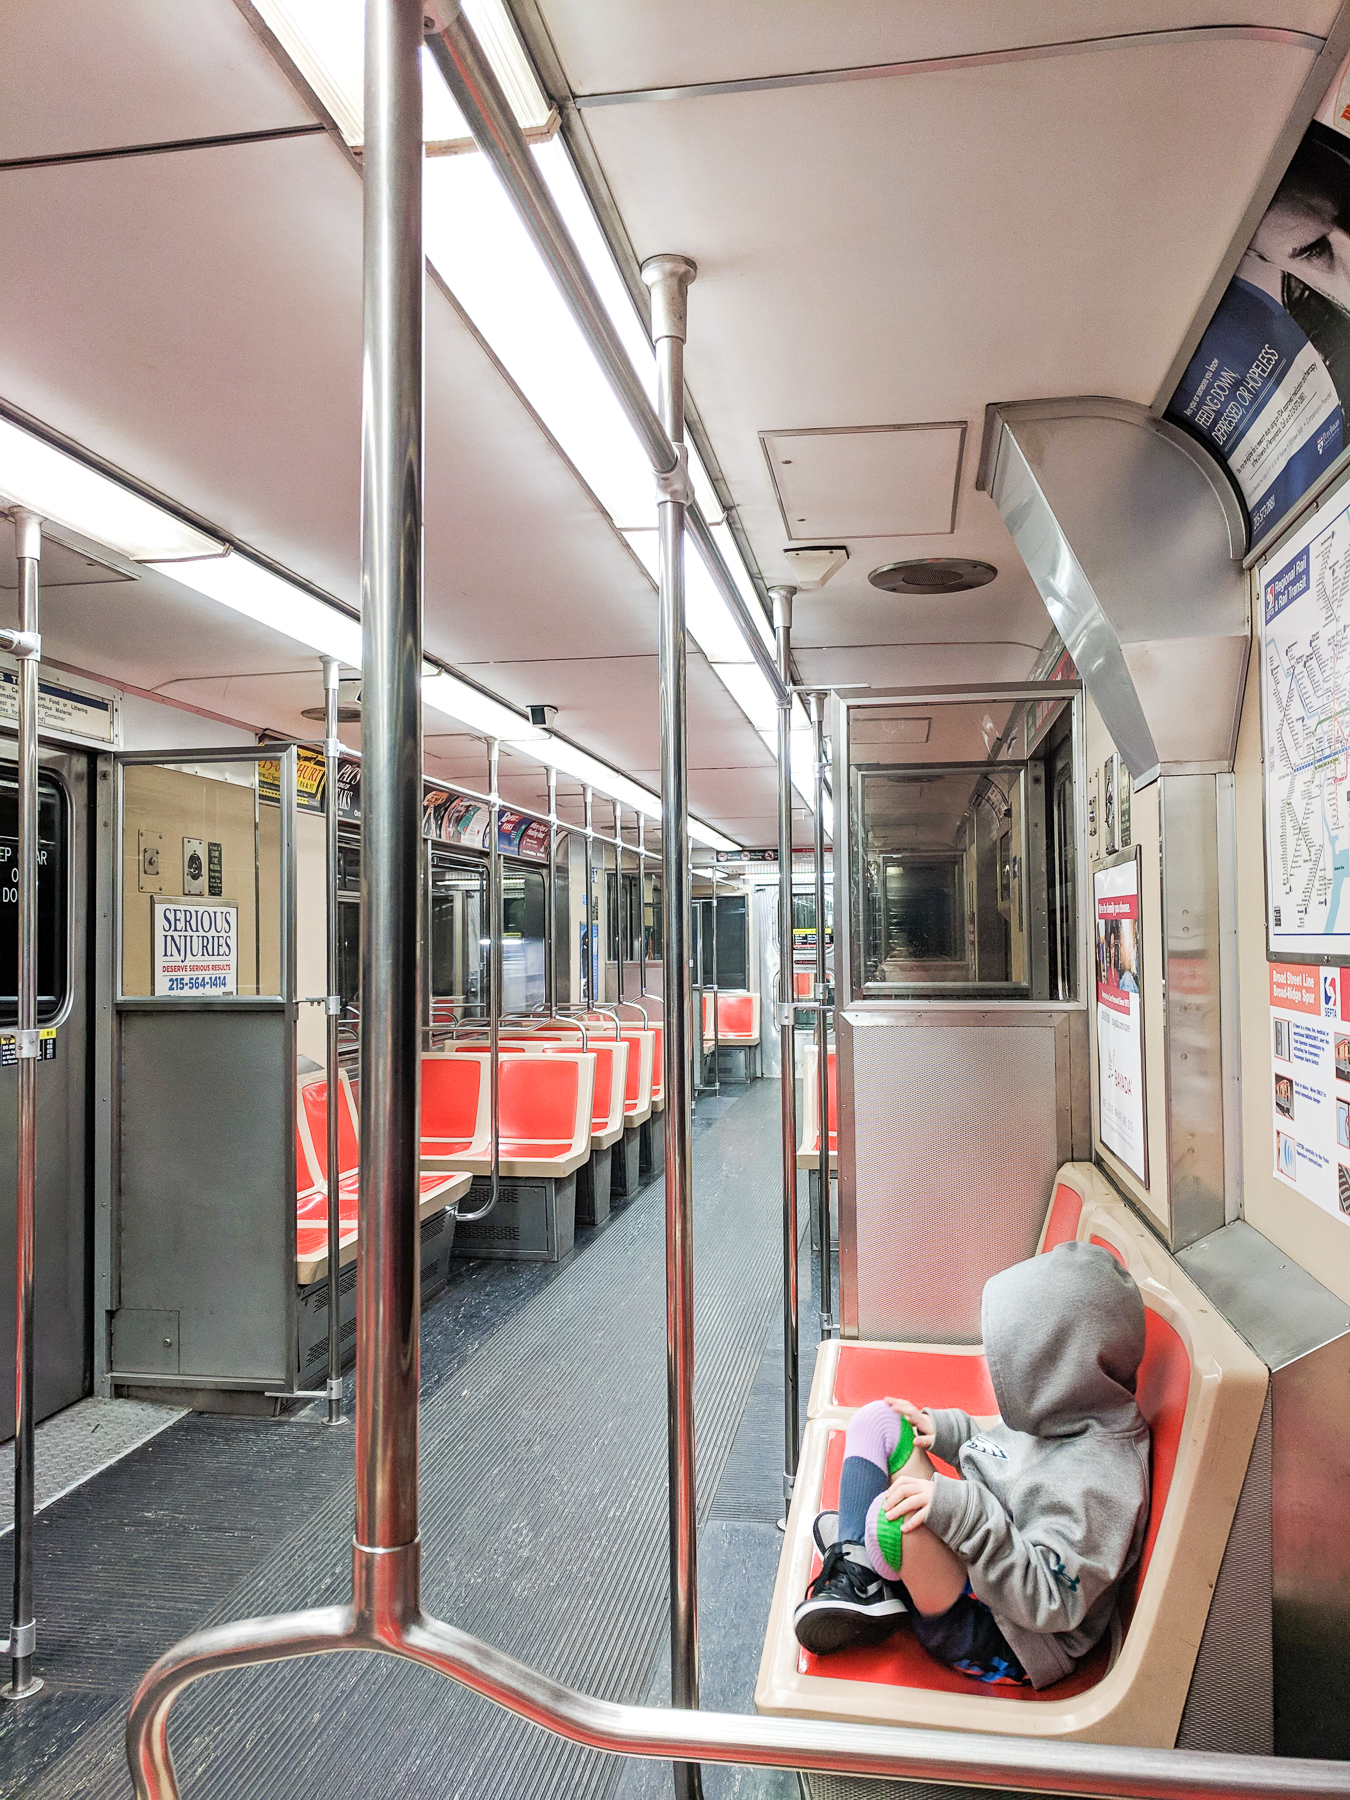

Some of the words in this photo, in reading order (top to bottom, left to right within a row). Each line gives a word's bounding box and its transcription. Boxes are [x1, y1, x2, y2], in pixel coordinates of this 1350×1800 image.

[1243, 344, 1279, 394] HOPELESS
[1195, 395, 1221, 430] FEELING
[1210, 366, 1241, 402] DOWN,
[1236, 386, 1254, 406] OR
[1212, 401, 1247, 445] DEPRESSED,
[1275, 565, 1295, 594] Regional
[1296, 555, 1306, 575] Rail
[1275, 600, 1278, 612] &
[1279, 590, 1287, 608] Rail
[1288, 575, 1306, 600] Transit
[297, 762, 325, 783] HURT
[163, 908, 231, 933] SERIOUS
[163, 935, 231, 963] INJURIES
[189, 964, 210, 972] SERIOUS
[1273, 969, 1286, 983] Broad
[1287, 971, 1302, 986] Street
[1303, 973, 1314, 988] Line
[168, 976, 226, 991] 215-564-1414
[1273, 985, 1302, 1003] Broad-Ridge
[1302, 989, 1315, 1005] Spur
[1325, 1007, 1337, 1018] SEPTA
